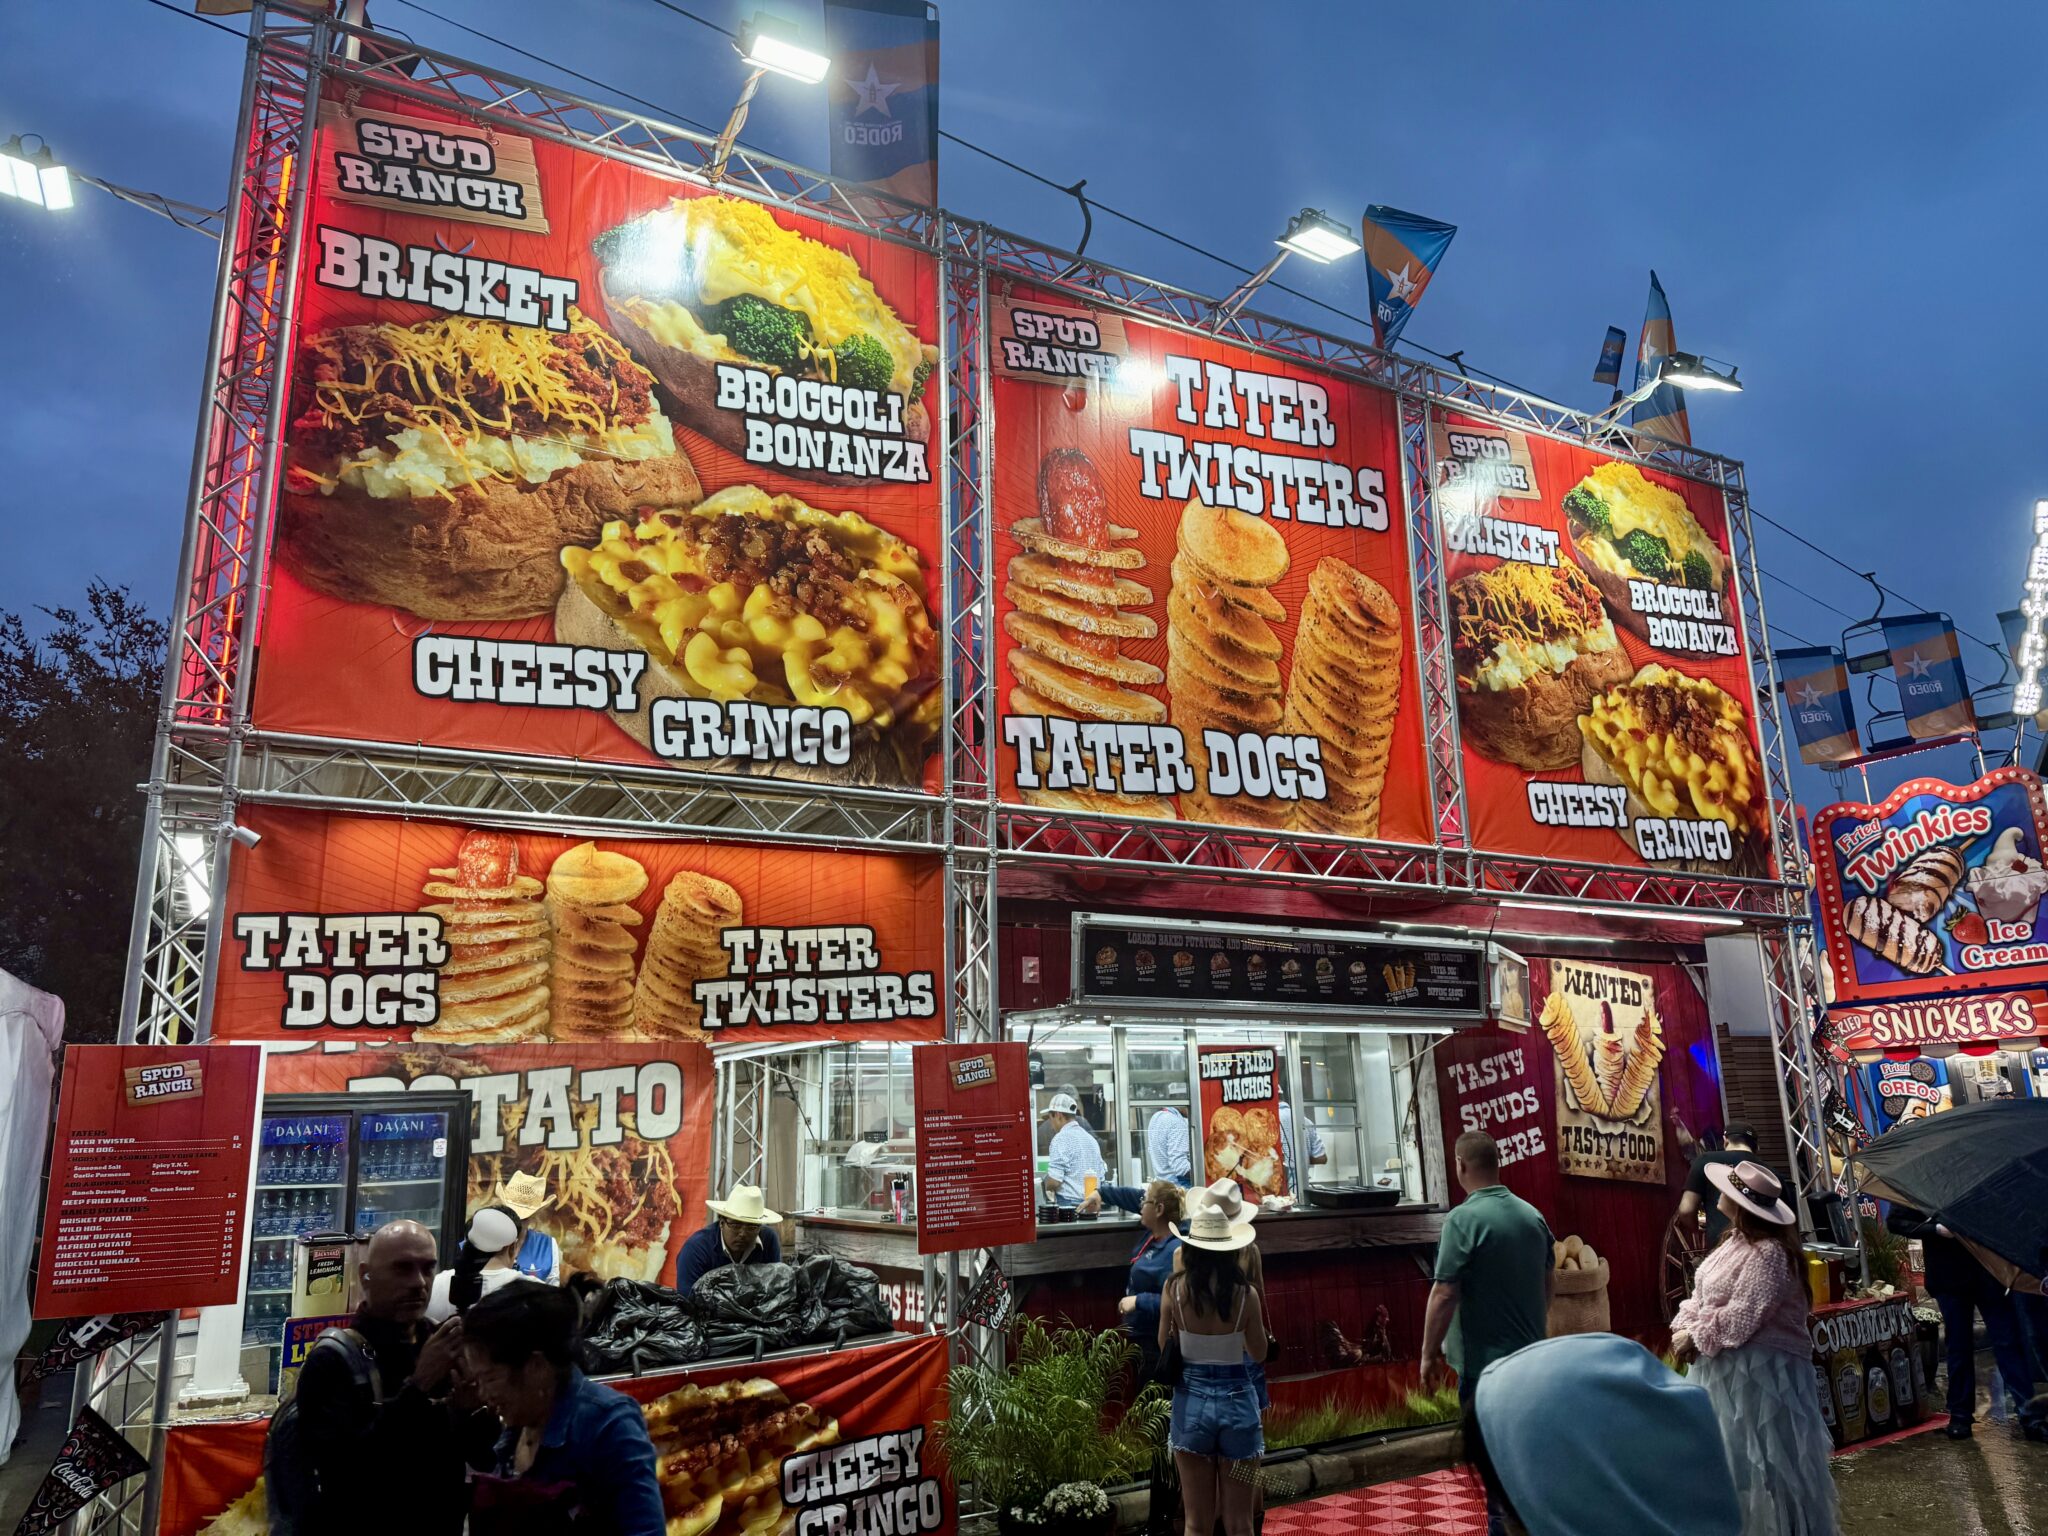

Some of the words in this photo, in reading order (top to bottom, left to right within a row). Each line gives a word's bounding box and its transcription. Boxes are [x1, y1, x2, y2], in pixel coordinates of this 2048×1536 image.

[360, 121, 493, 173] SPUD
[340, 155, 523, 216] RANCH
[317, 228, 577, 332] BRISKET
[1014, 311, 1099, 347] SPUD
[1006, 342, 1119, 384] RANCH
[716, 364, 903, 434] BROCCOLI
[1166, 355, 1335, 446] TATER
[744, 419, 929, 482] BONANZA
[1450, 433, 1510, 461] SPUD
[1130, 430, 1389, 531] TWISTERS
[1630, 580, 1722, 620] BROCCOLI
[1648, 616, 1739, 655] BONANZA
[415, 636, 647, 711] CHEESY
[650, 699, 852, 765] GRINGO
[1004, 715, 1193, 794] TATER
[1203, 729, 1327, 799] DOGS
[1528, 781, 1628, 828] CHEESY
[1635, 818, 1733, 861] GRINGO
[1837, 818, 1882, 853] Fried
[1845, 804, 1992, 892] Twinkies
[236, 915, 447, 970] TATER
[722, 927, 879, 974] TATER
[1989, 920, 2030, 942] Ice
[1963, 945, 2048, 967] Cream
[285, 973, 440, 1027] DOGS
[694, 972, 936, 1029] TWISTERS
[1564, 967, 1643, 1007] WANTED
[1837, 1015, 1862, 1036] RIED
[1870, 997, 2036, 1042] SNICKERS
[141, 1065, 184, 1083] SPUD
[956, 1067, 991, 1085] RANCH
[959, 1058, 985, 1072] SPUD
[1201, 1054, 1233, 1079] DEEP
[1237, 1050, 1274, 1076] FRIED
[1448, 1048, 1526, 1094] TASTY
[1880, 1062, 1911, 1076] Fried
[134, 1078, 193, 1099] RANCH
[1222, 1076, 1272, 1103] NACHOS
[1880, 1081, 1940, 1103] OREOS
[375, 1121, 425, 1133] DASANI
[1460, 1086, 1540, 1133] SPUDS
[276, 1124, 329, 1138] DASANI
[1496, 1126, 1547, 1168] ERE
[1562, 1126, 1613, 1158] TASTY
[1619, 1132, 1657, 1163] FOOD
[59, 1217, 97, 1225] BRISKET
[93, 1232, 132, 1240] BUFFALO
[54, 1260, 98, 1268] BROCCOLI
[99, 1257, 140, 1265] BONANZA
[55, 1251, 90, 1259] CHEEZY
[309, 1265, 342, 1275] LEMONADE
[52, 1278, 83, 1286] RANCH
[1812, 1301, 1914, 1354] CONDIMENTS
[51, 1462, 101, 1499] Coca-Cola
[783, 1428, 924, 1503] CHEESY
[799, 1479, 941, 1536] GRINGO
